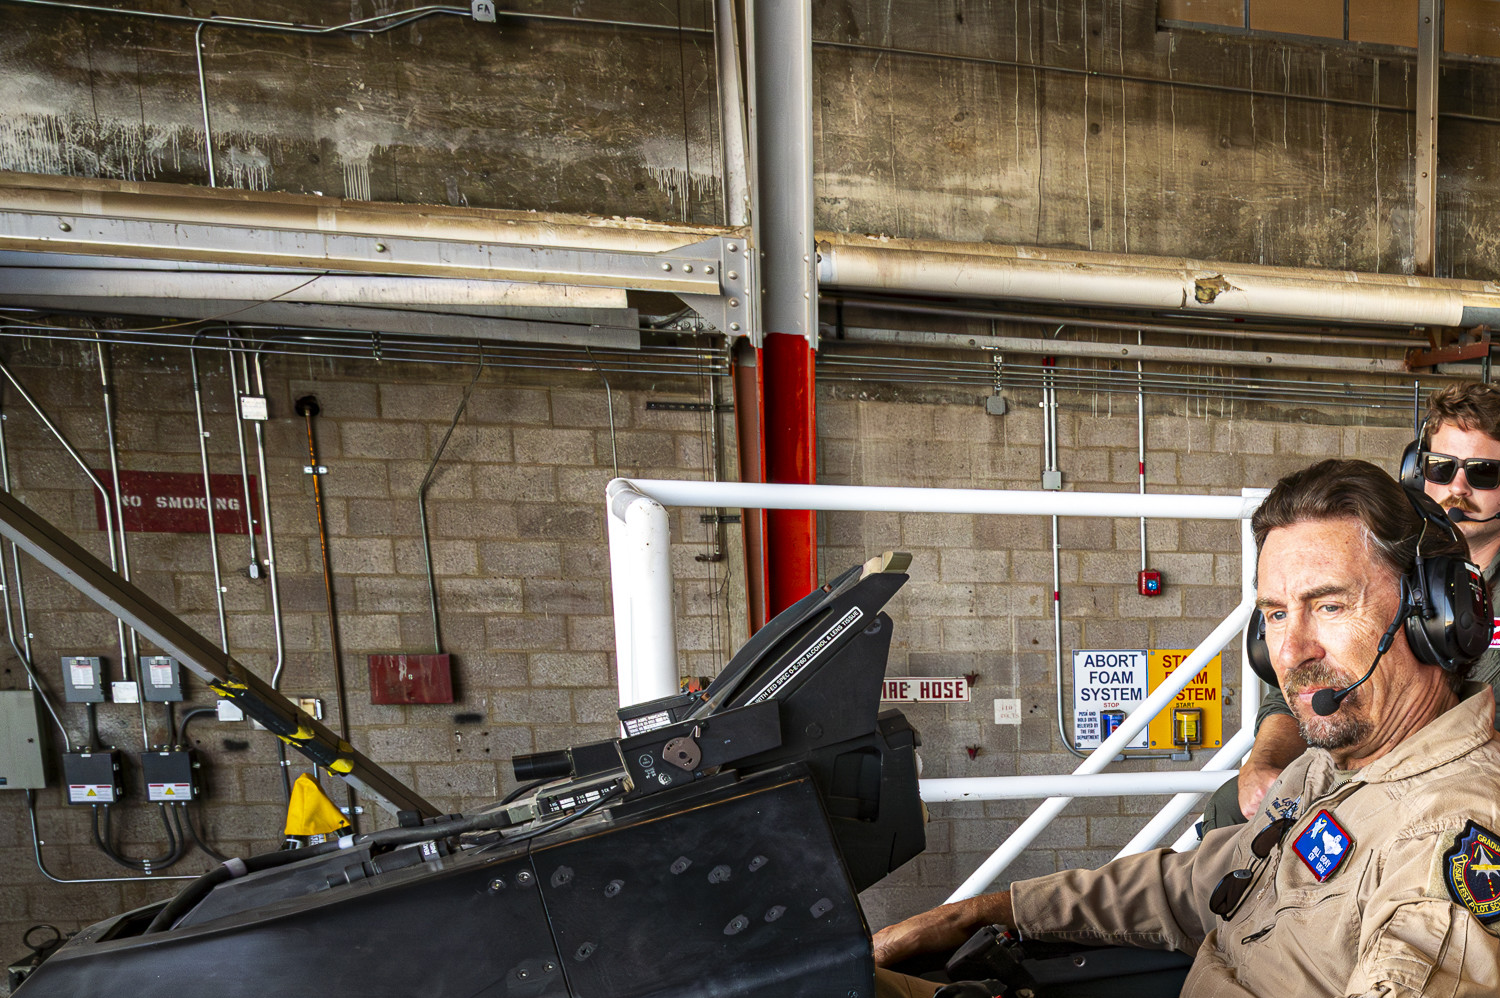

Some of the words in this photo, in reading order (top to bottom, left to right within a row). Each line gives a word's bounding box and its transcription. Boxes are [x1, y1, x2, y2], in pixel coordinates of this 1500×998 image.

[156, 496, 240, 511] SMOKNG
[766, 684, 778, 695] FED
[777, 672, 791, 686] SPEC
[805, 639, 828, 659] ALCOHOL
[830, 624, 843, 638] LENS
[841, 610, 860, 627] TISSUE
[1084, 654, 1138, 668] ABORT
[1089, 671, 1133, 684] FOAM
[882, 682, 908, 699] IRE
[920, 682, 963, 698] HOSE
[1081, 688, 1142, 701] SYSTEM
[1175, 688, 1216, 701] STEM
[1458, 882, 1471, 901] TEST
[1469, 901, 1489, 913] PILOT
